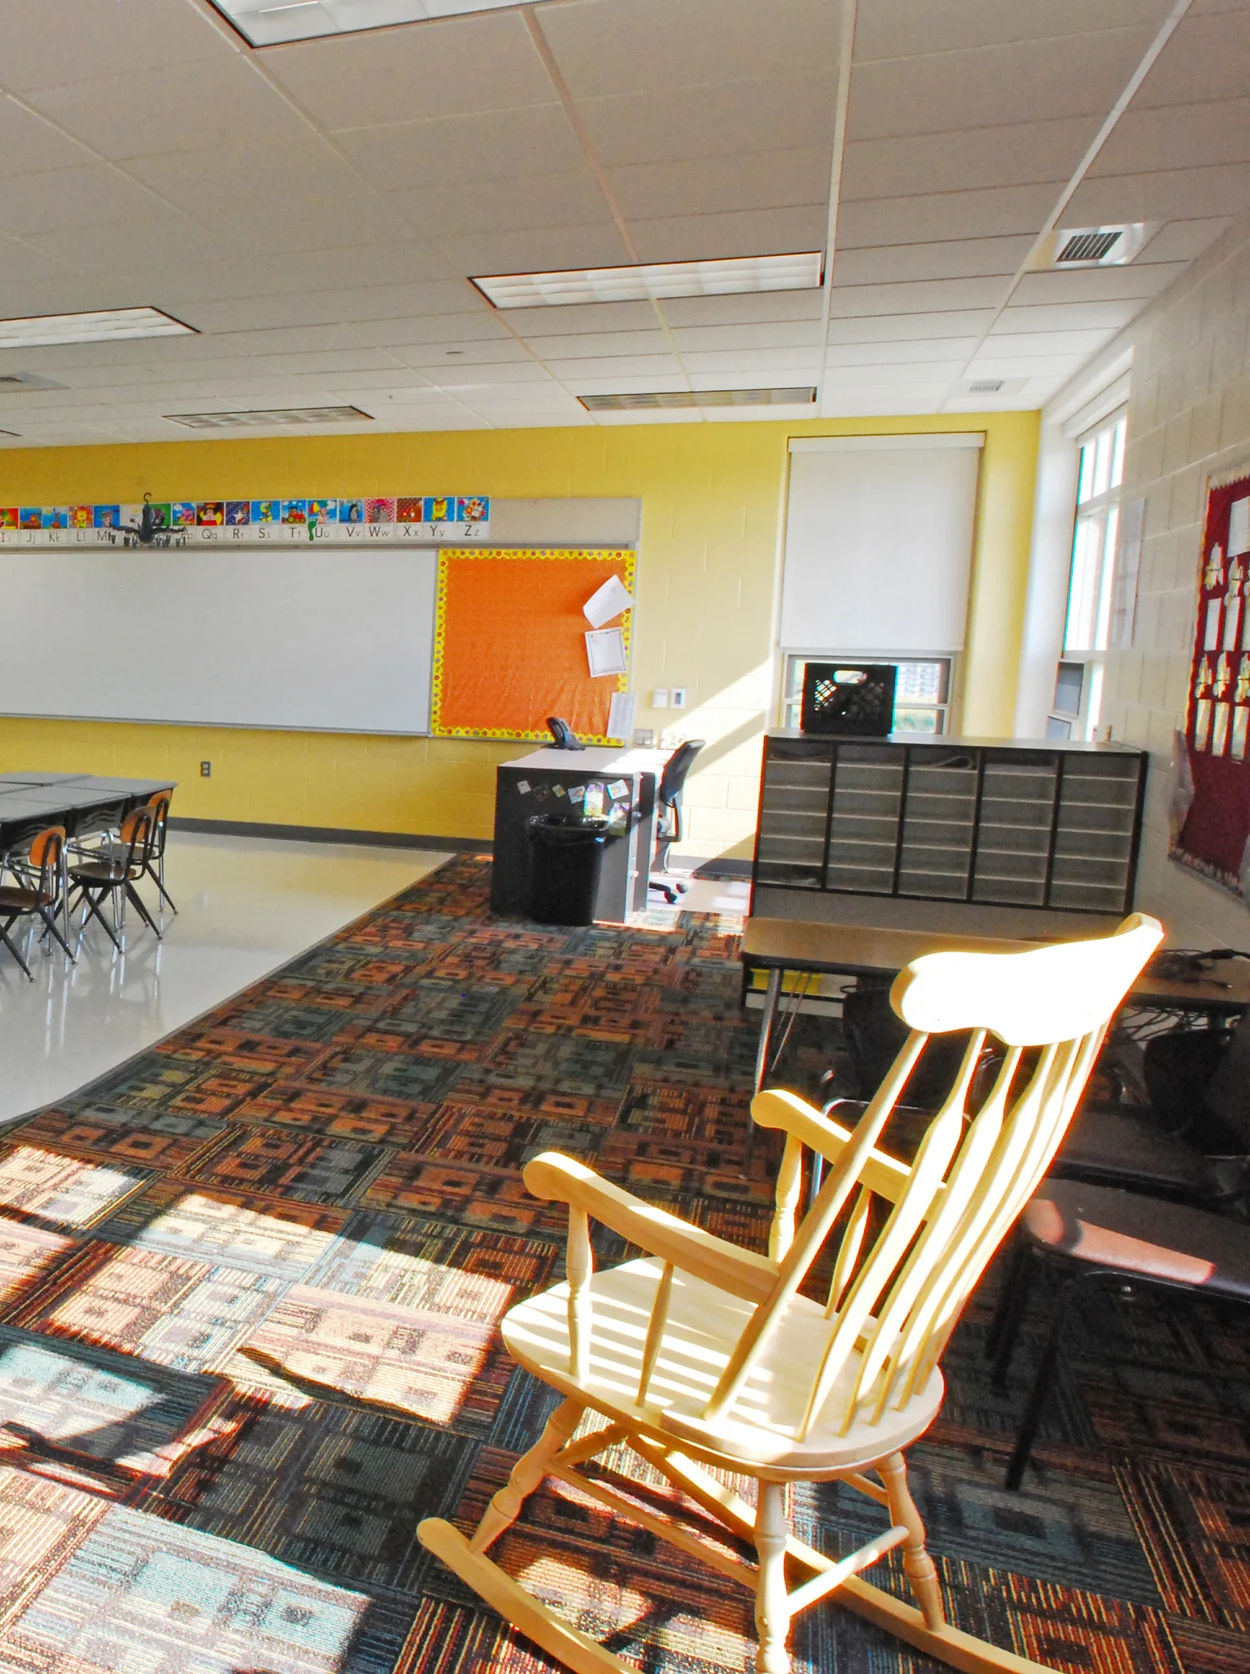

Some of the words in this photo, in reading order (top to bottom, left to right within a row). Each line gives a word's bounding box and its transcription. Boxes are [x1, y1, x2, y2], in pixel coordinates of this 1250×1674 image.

[202, 528, 217, 540] Qq
[259, 527, 271, 538] Ss
[289, 527, 301, 538] Tt
[346, 526, 361, 538] Vv
[369, 527, 389, 537] Ww
[403, 526, 418, 536] Xx
[430, 526, 445, 538] Yy
[464, 525, 480, 536] Zz
